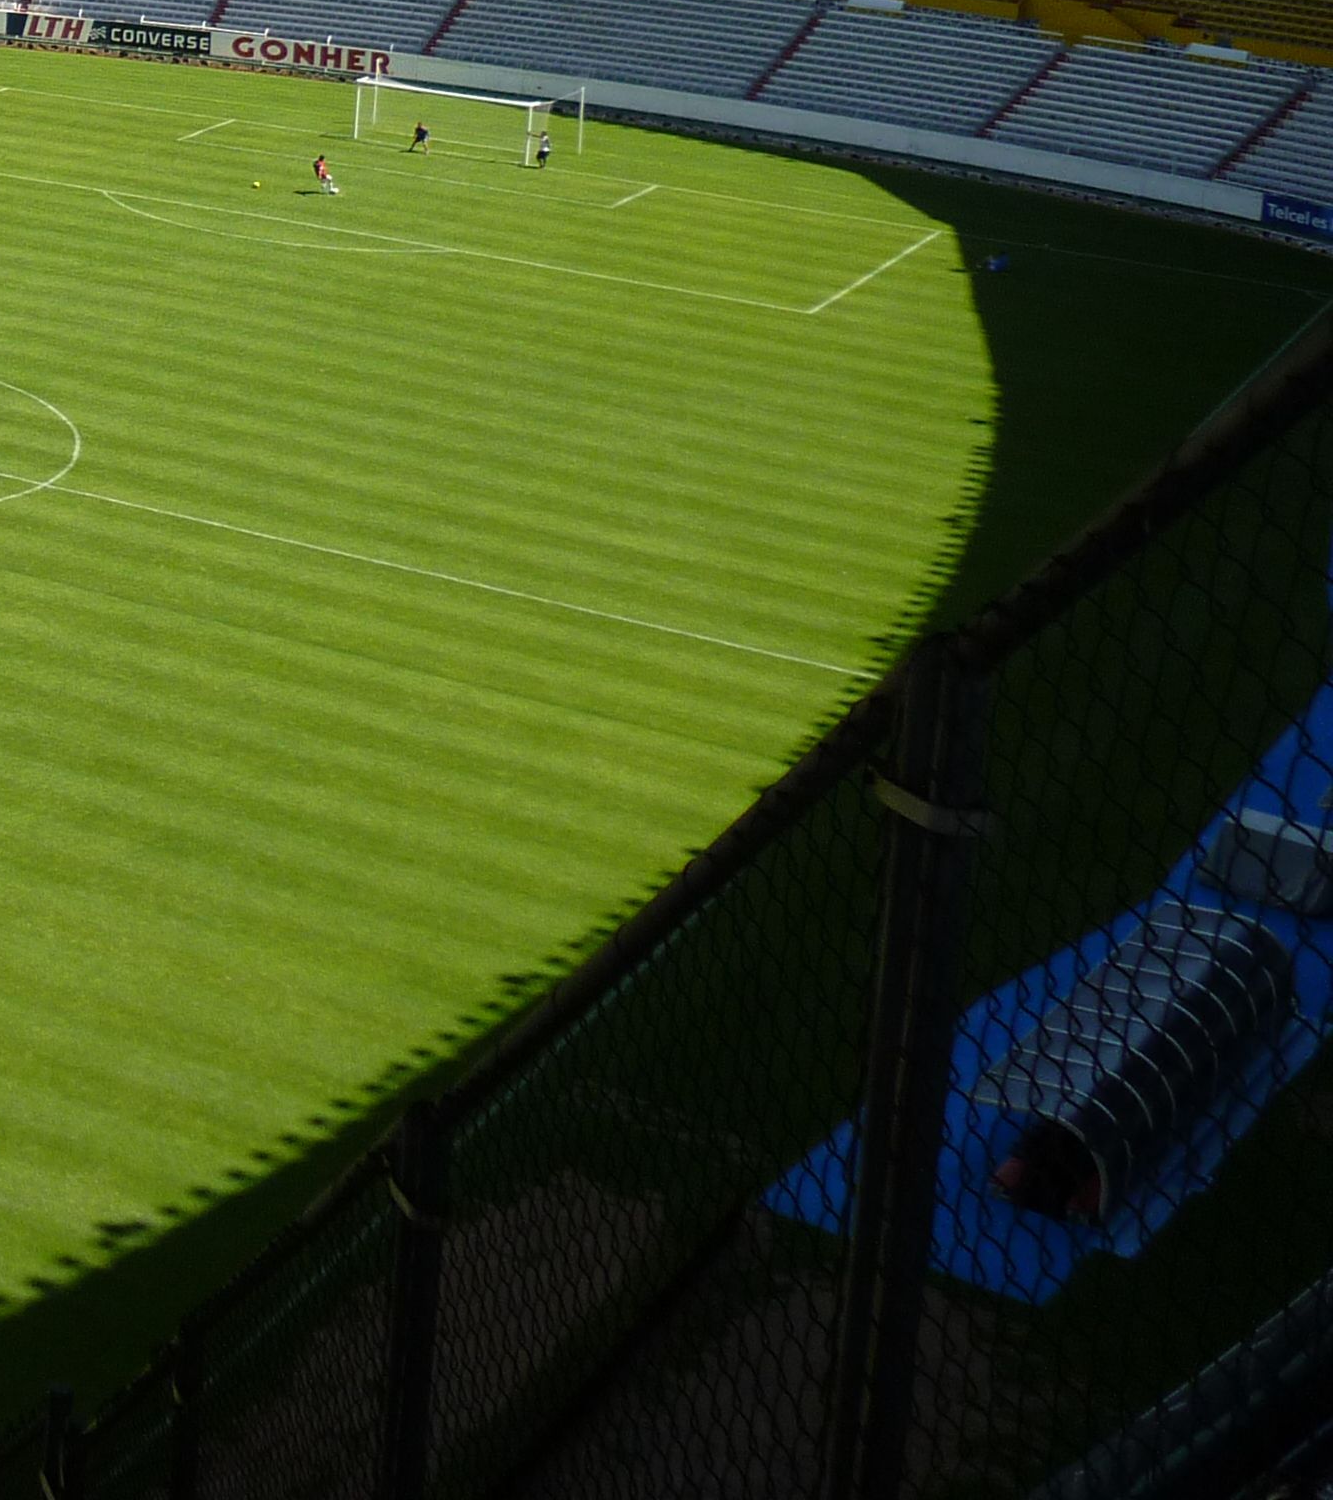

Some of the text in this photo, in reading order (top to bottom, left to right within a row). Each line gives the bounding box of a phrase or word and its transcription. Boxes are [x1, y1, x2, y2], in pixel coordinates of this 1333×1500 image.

[27, 15, 85, 41] LTH
[110, 27, 210, 51] CONVERSE
[232, 35, 391, 76] GONHER
[1267, 202, 1328, 231] Telcel es
